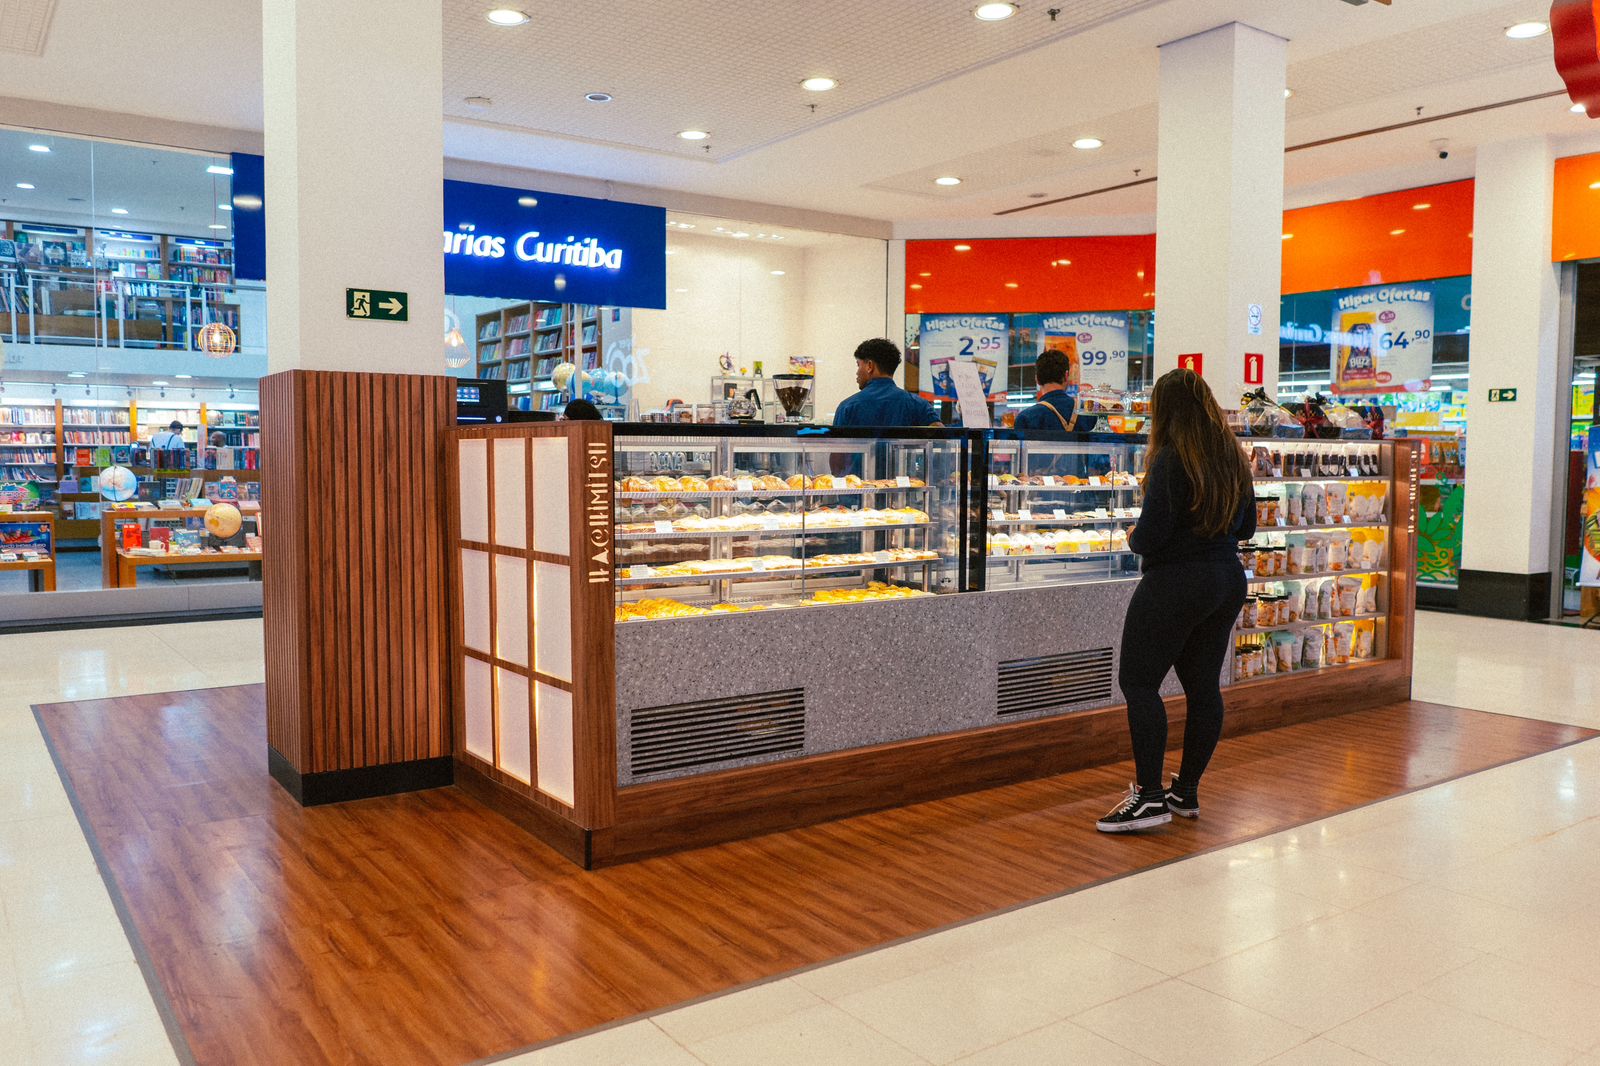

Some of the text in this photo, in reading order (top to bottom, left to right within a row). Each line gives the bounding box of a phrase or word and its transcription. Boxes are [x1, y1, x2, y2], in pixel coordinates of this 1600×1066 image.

[516, 231, 622, 269] Curitiba
[1338, 288, 1431, 310] Hiper Ofertas
[925, 317, 1005, 332] Hiper Ofertas
[1043, 314, 1125, 329] Hiper Ofertas
[586, 442, 610, 583] HACHIMITSU
